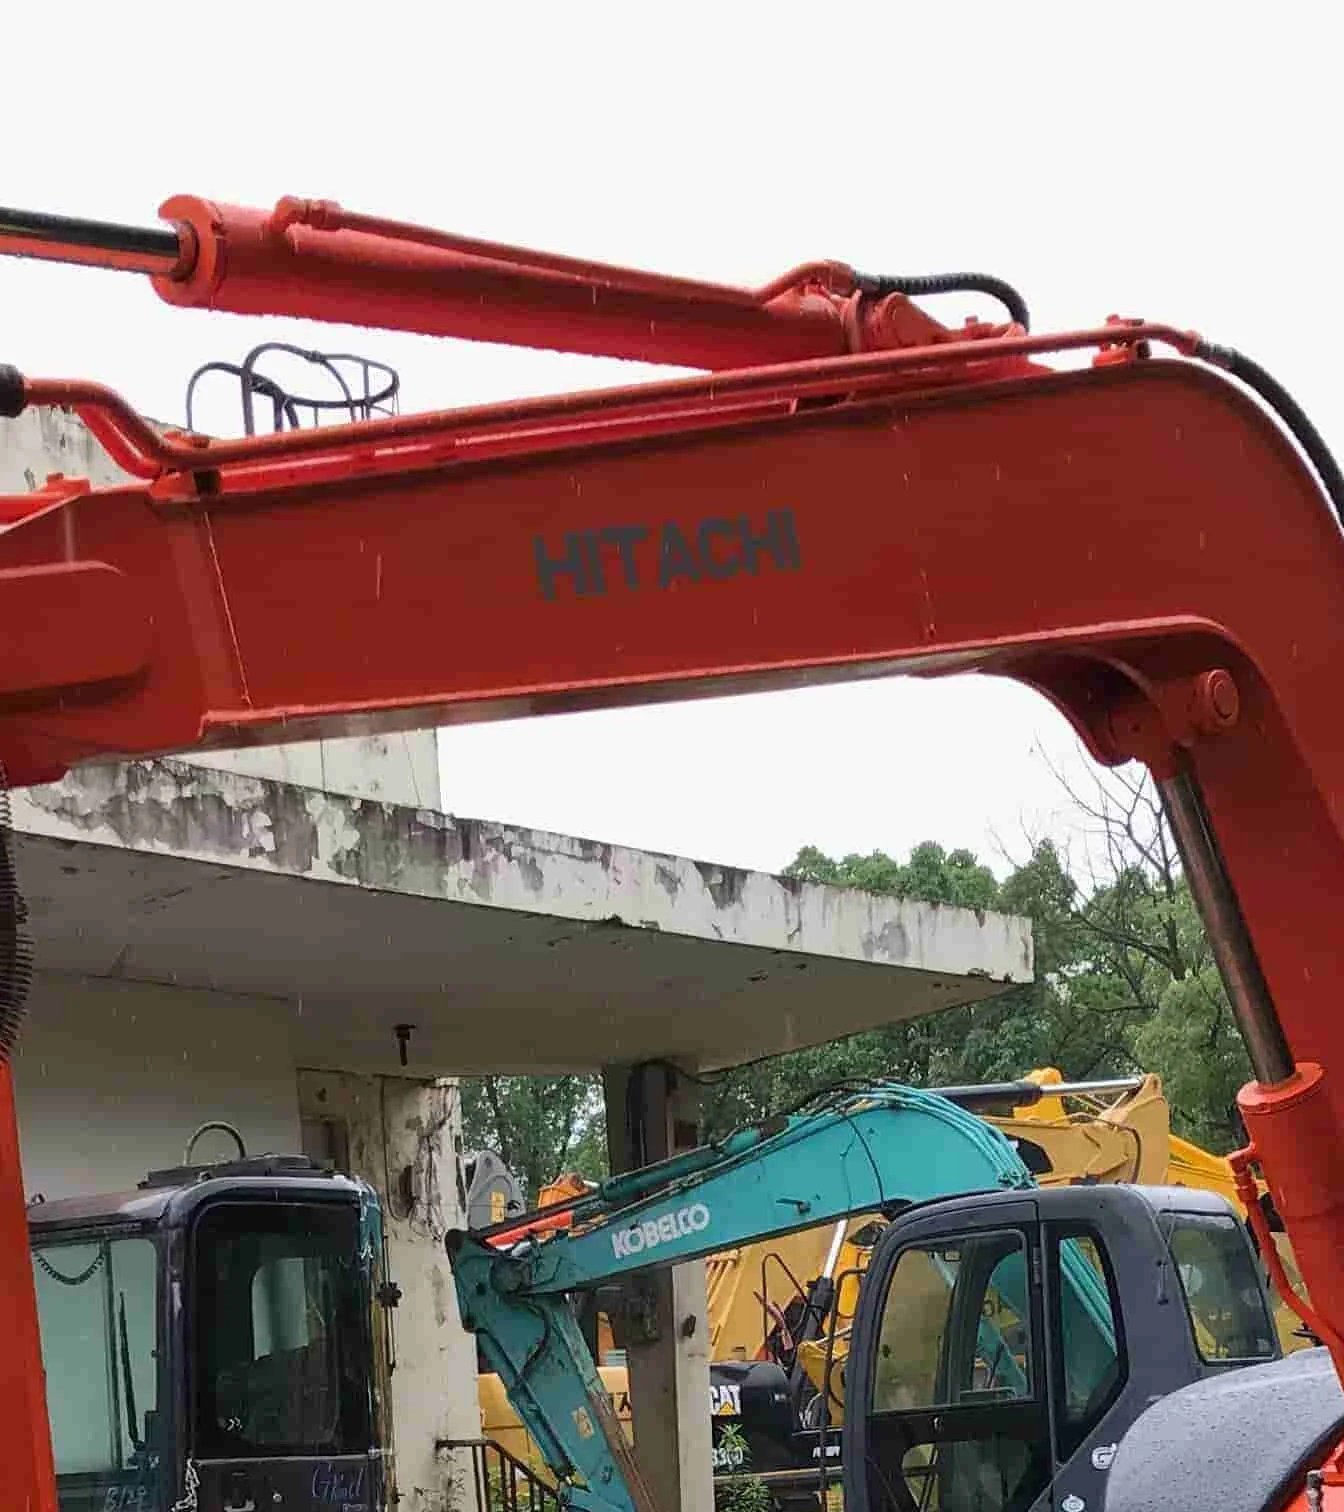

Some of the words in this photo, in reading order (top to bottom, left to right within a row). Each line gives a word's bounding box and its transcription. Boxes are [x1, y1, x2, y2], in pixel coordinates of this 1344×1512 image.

[532, 505, 801, 603] HITACHI
[611, 1203, 710, 1258] KOBELCO
[709, 1385, 741, 1416] CAT
